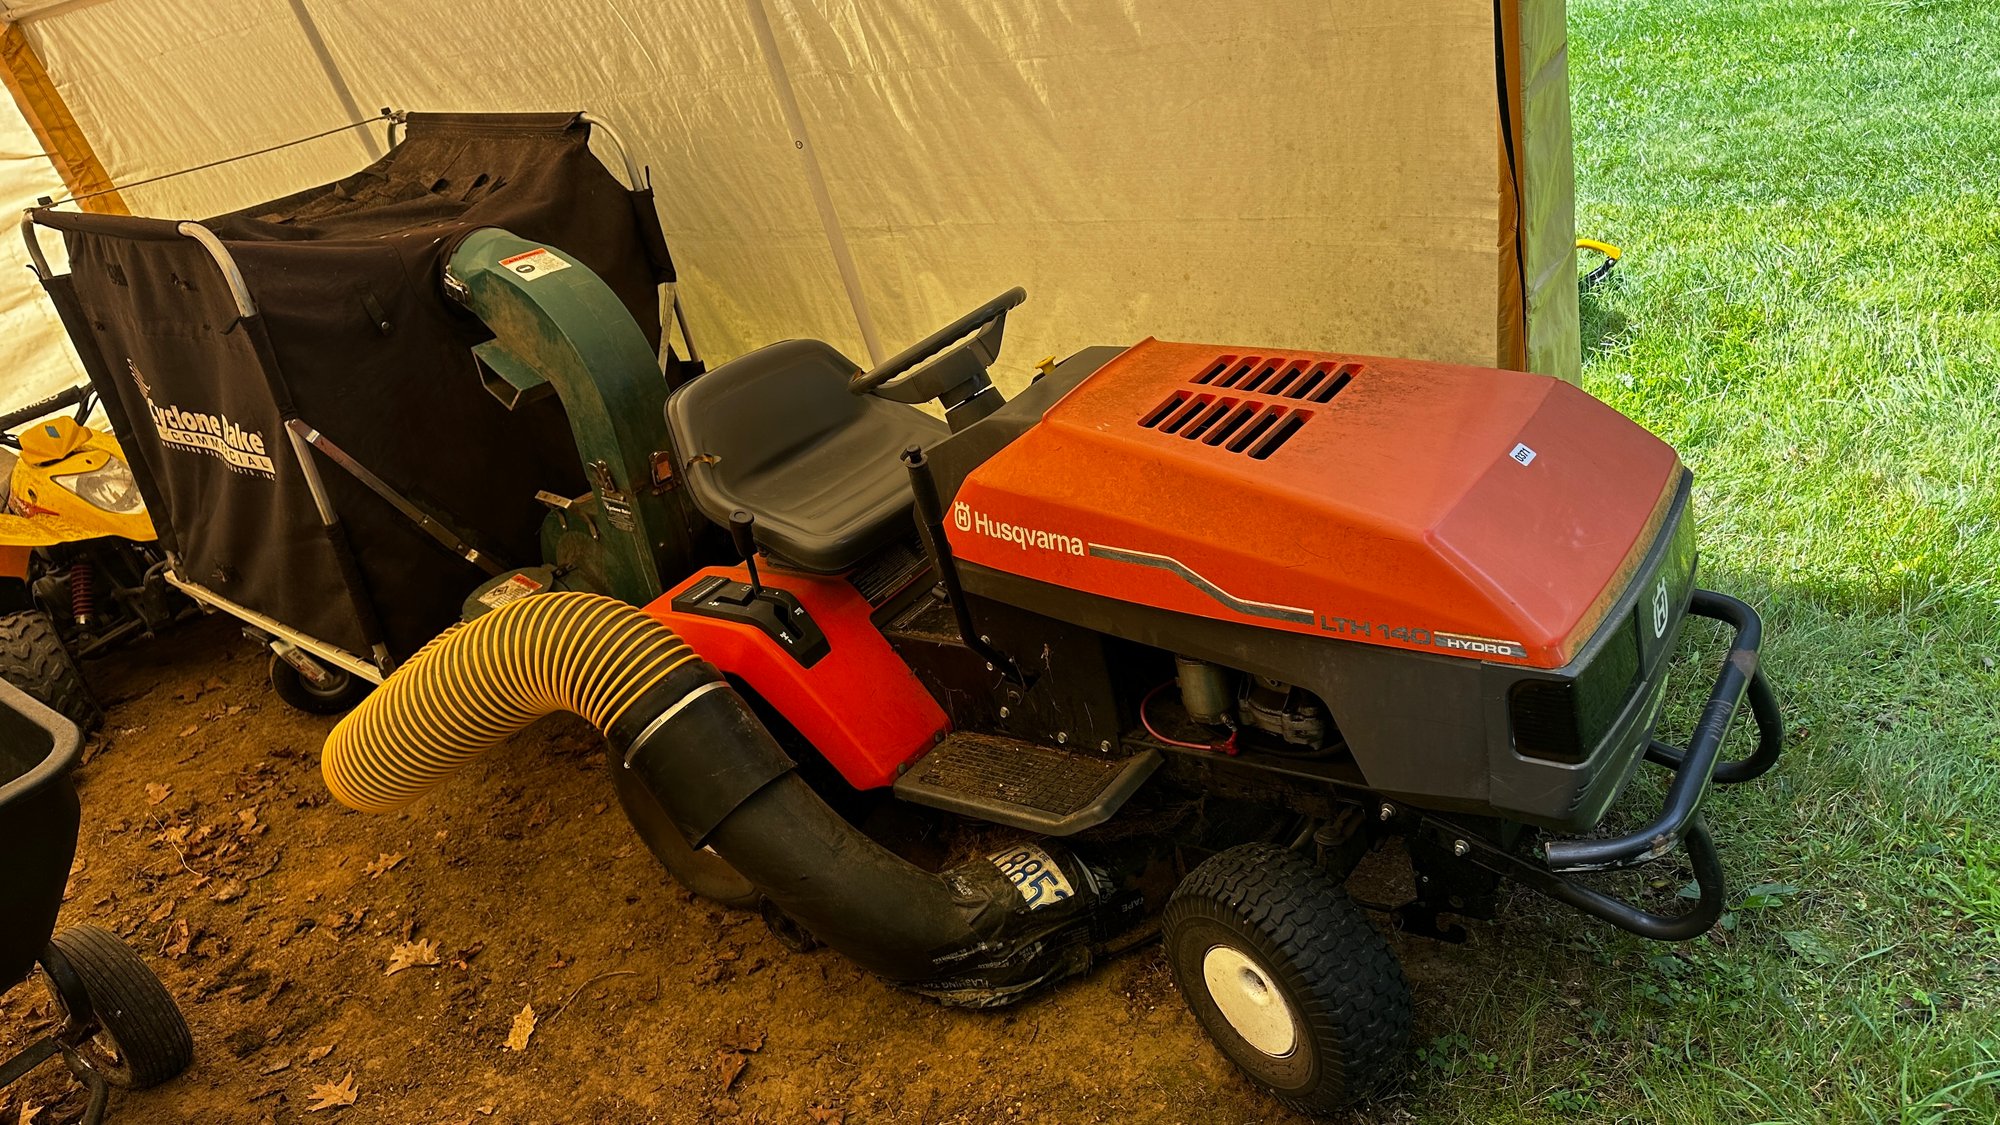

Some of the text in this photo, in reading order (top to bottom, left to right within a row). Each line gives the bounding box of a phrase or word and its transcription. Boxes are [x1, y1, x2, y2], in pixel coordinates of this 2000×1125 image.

[147, 397, 222, 437] Cyclone
[974, 511, 1085, 556] Husqvarna
[1320, 615, 1512, 656] LTH 140 HYDRO
